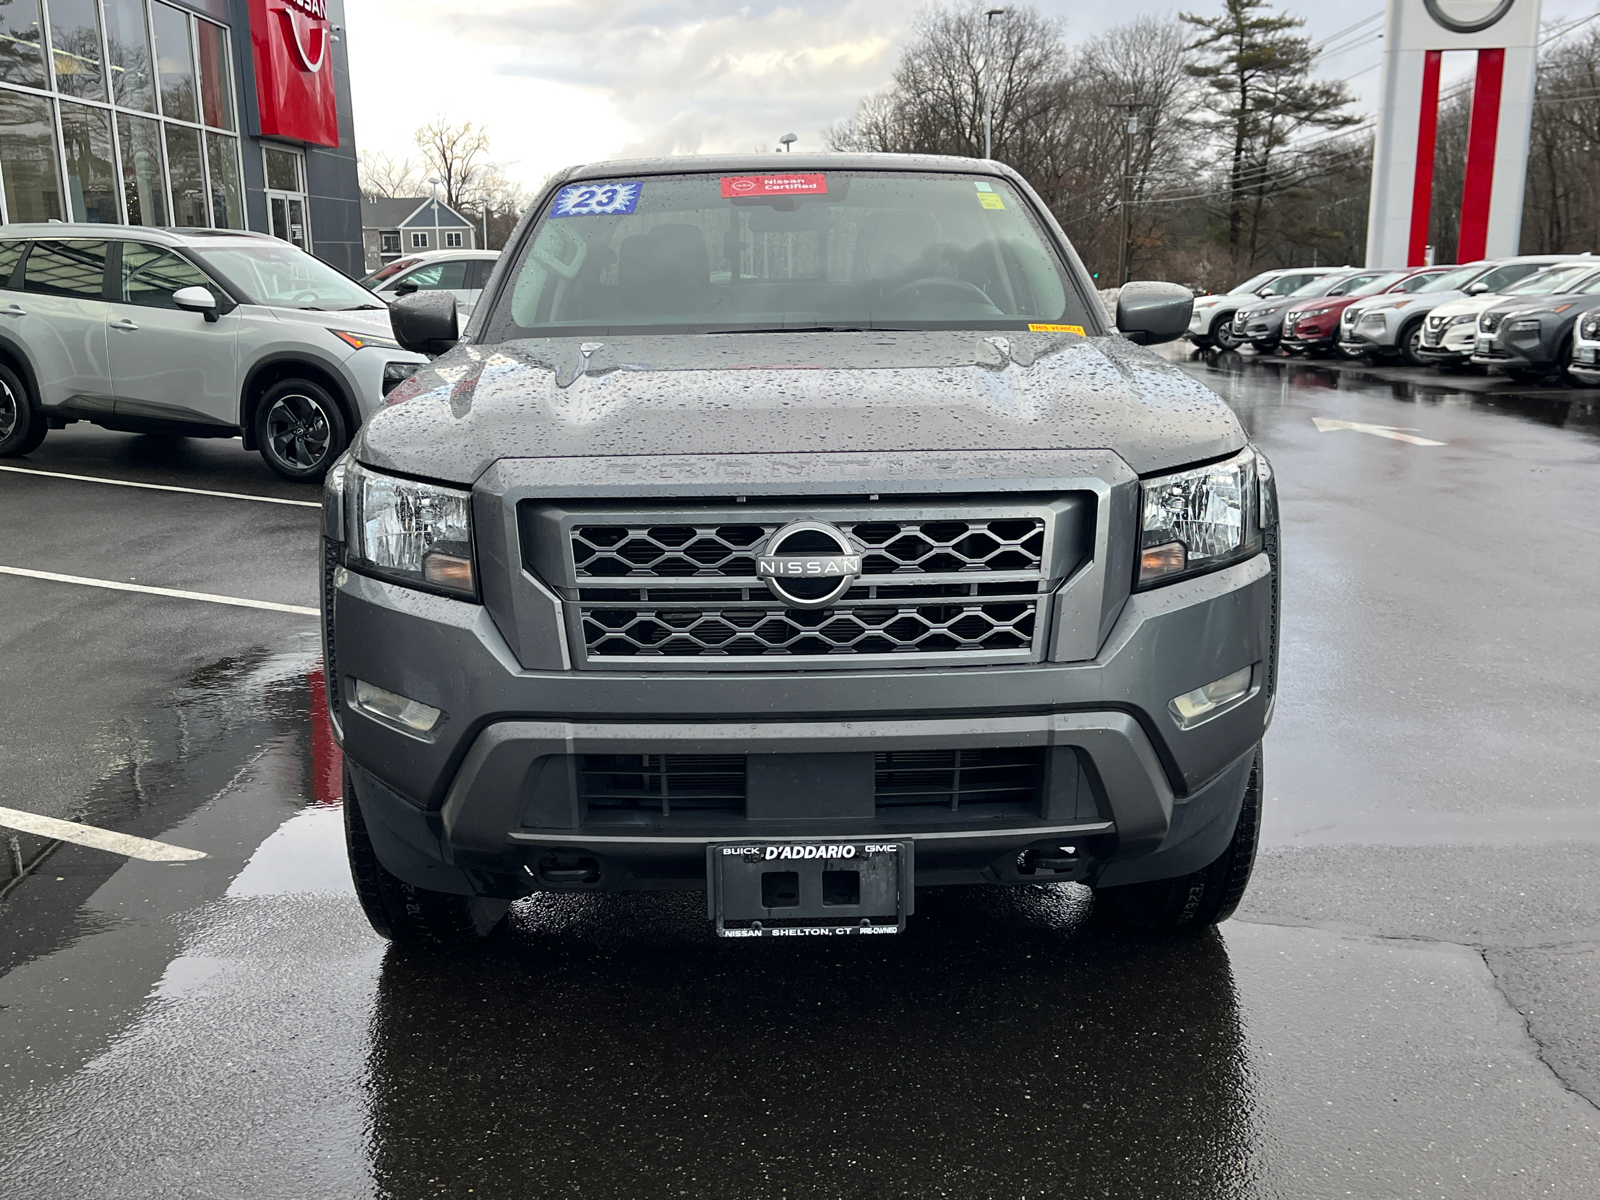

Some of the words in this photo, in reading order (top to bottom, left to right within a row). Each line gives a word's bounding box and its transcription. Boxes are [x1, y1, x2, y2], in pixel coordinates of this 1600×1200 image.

[571, 188, 619, 208] 23
[760, 560, 858, 574] NISSAN
[723, 847, 760, 855] BUICK
[765, 845, 856, 860] D'ADDARIO
[864, 844, 897, 852] GMC
[725, 929, 763, 937] NISSAN
[771, 927, 833, 937] SHELTON,
[835, 927, 853, 935] CT
